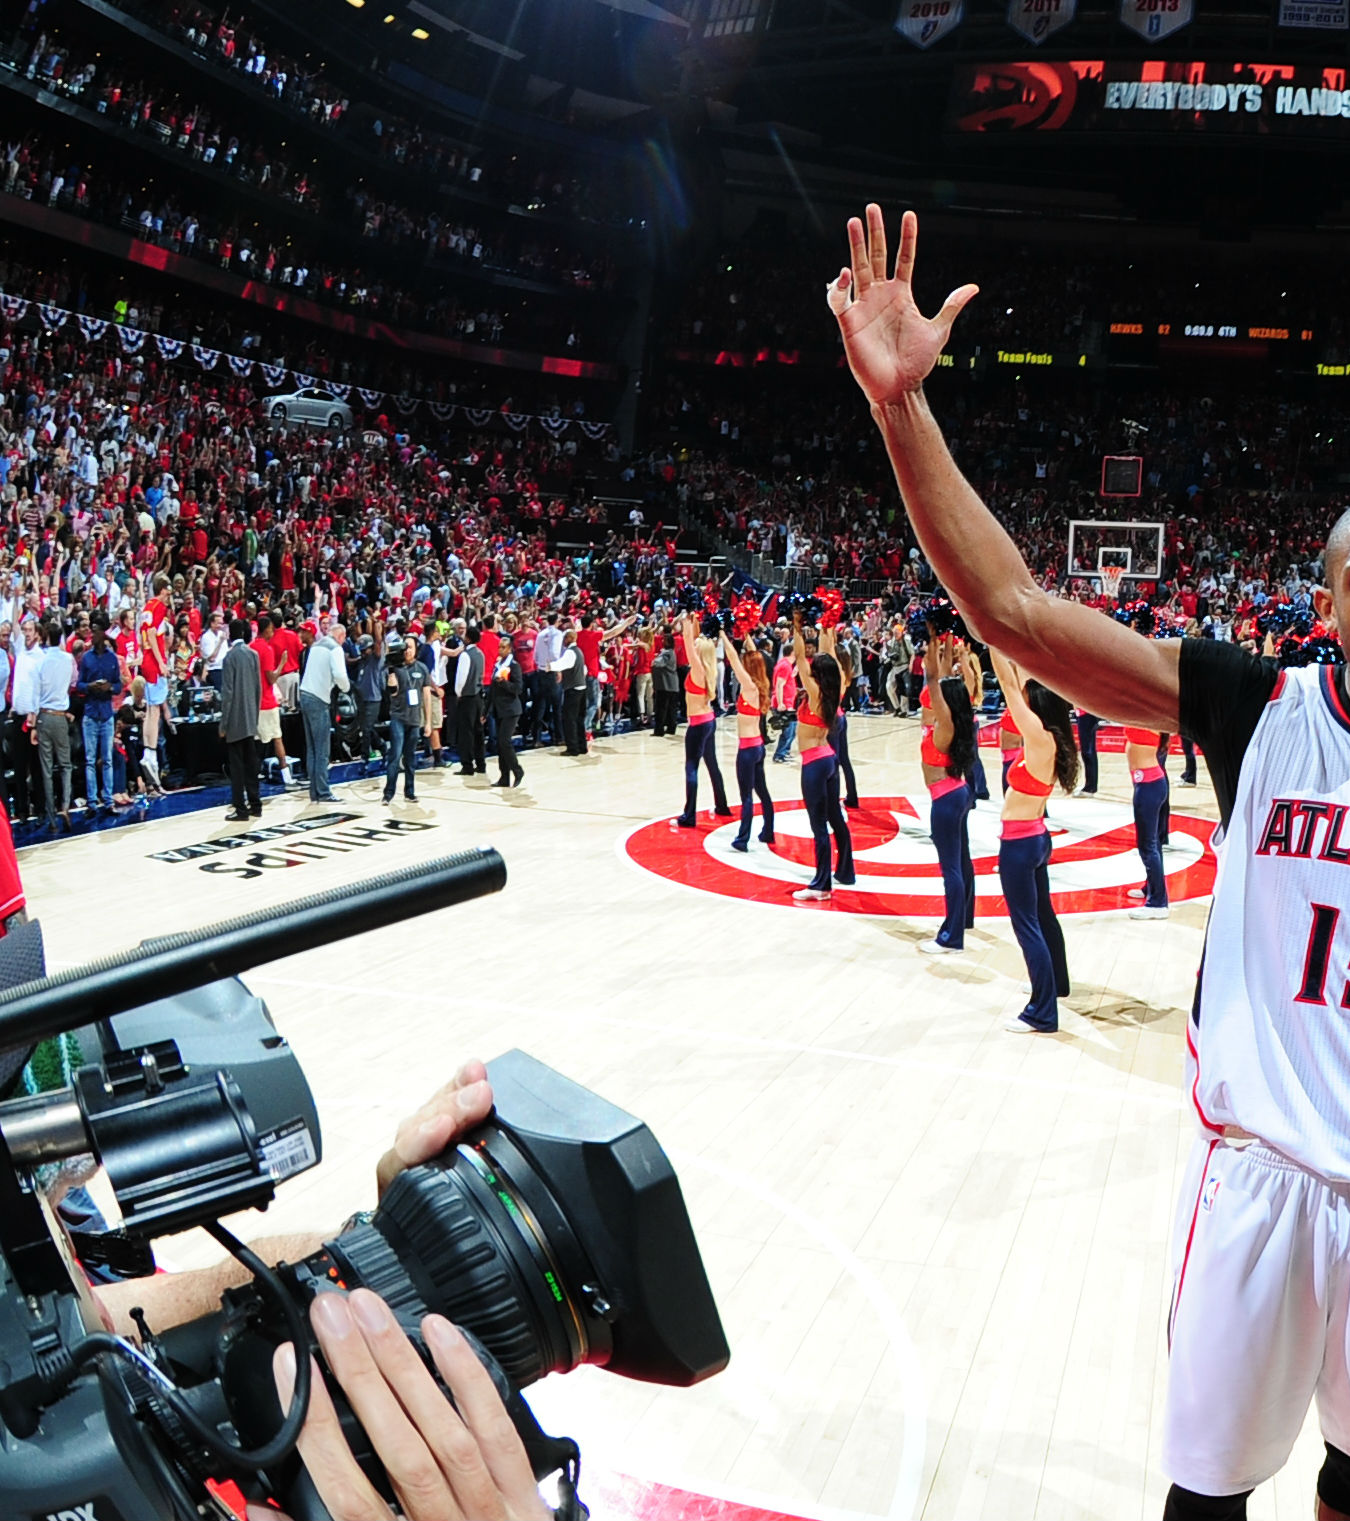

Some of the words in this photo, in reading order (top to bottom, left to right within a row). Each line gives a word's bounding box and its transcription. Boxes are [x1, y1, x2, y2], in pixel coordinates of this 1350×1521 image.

[909, 2, 949, 18] 2010
[1023, 0, 1061, 13] 2011
[1135, 0, 1179, 12] 2013
[1283, 12, 1345, 23] 1999-2013
[1104, 82, 1263, 113] EVERYBODY'S
[1110, 323, 1143, 335] HAWKS
[1248, 327, 1289, 340] WIZARDS
[937, 354, 954, 367] TOL
[969, 356, 976, 369] 1
[997, 350, 1025, 364] Team
[1025, 351, 1053, 365] Fouls
[1078, 354, 1086, 367] 4
[1316, 363, 1345, 376] Team
[151, 823, 308, 863] ARENA
[198, 819, 441, 879] PHILIPS
